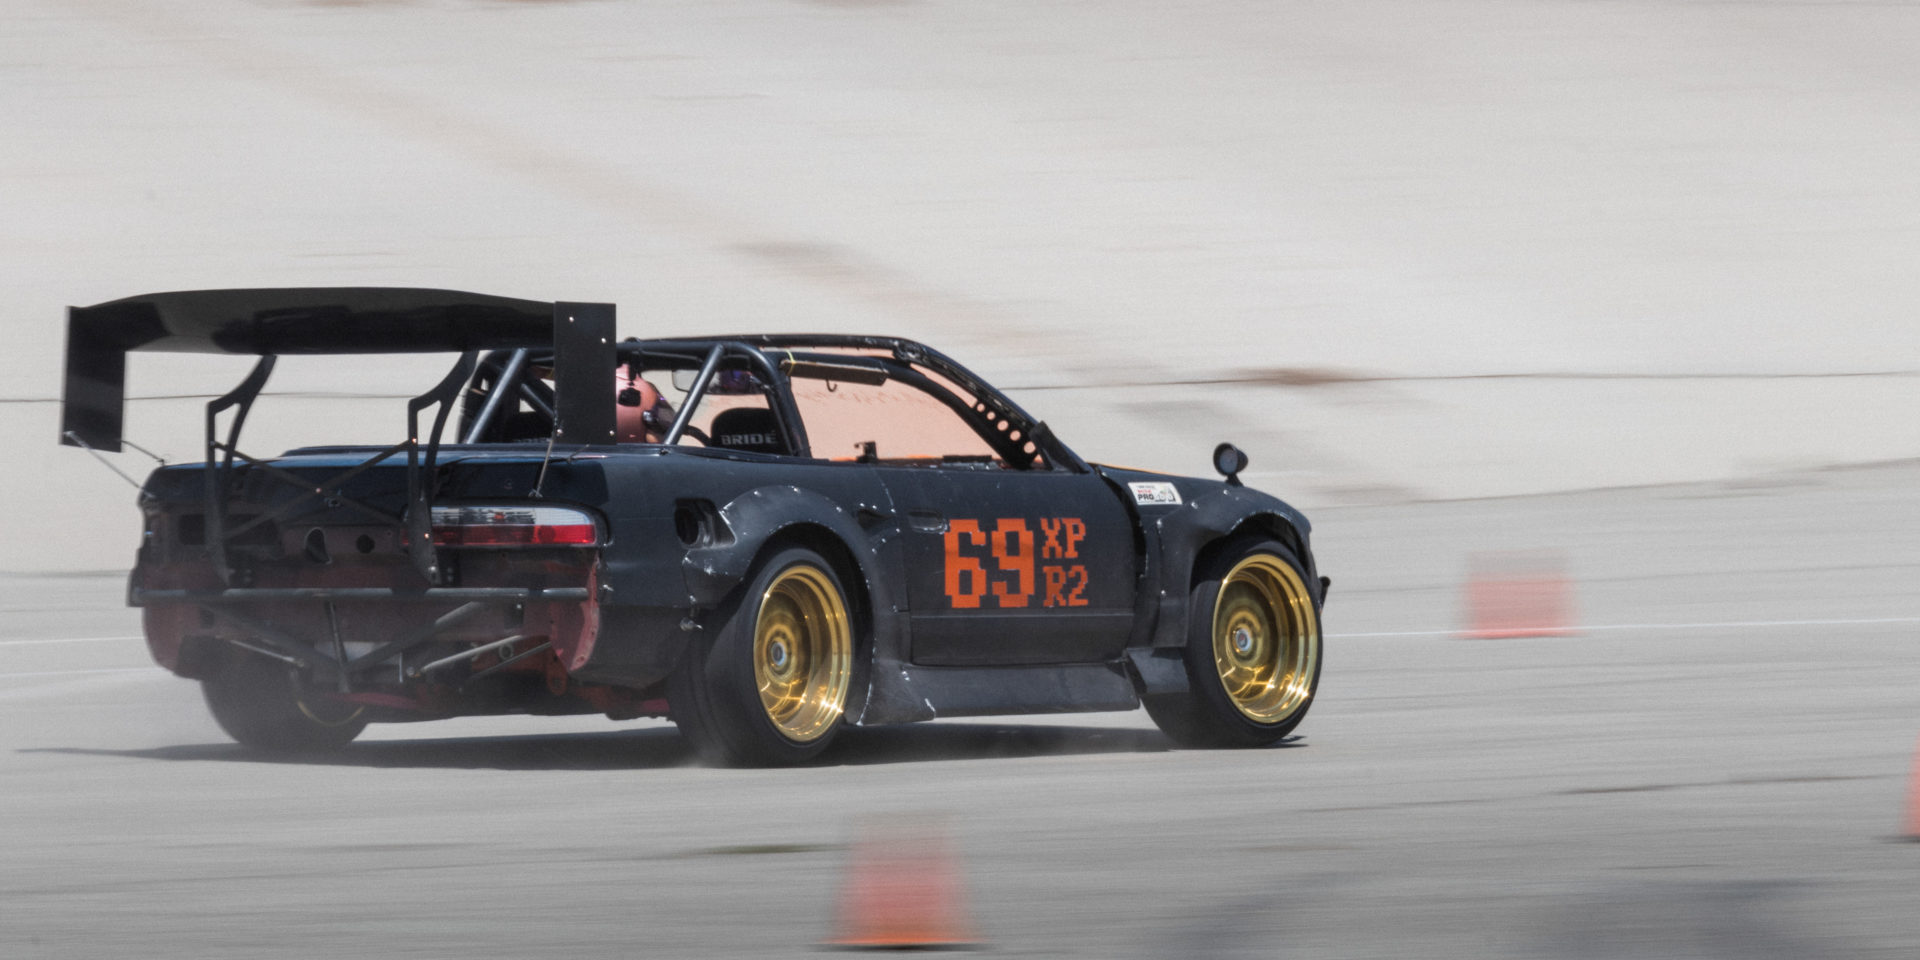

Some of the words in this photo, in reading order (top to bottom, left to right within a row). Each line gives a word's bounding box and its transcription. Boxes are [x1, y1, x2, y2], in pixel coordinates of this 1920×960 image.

[1040, 518, 1087, 559] XP
[944, 518, 1035, 608] 69
[1042, 565, 1089, 607] R2
